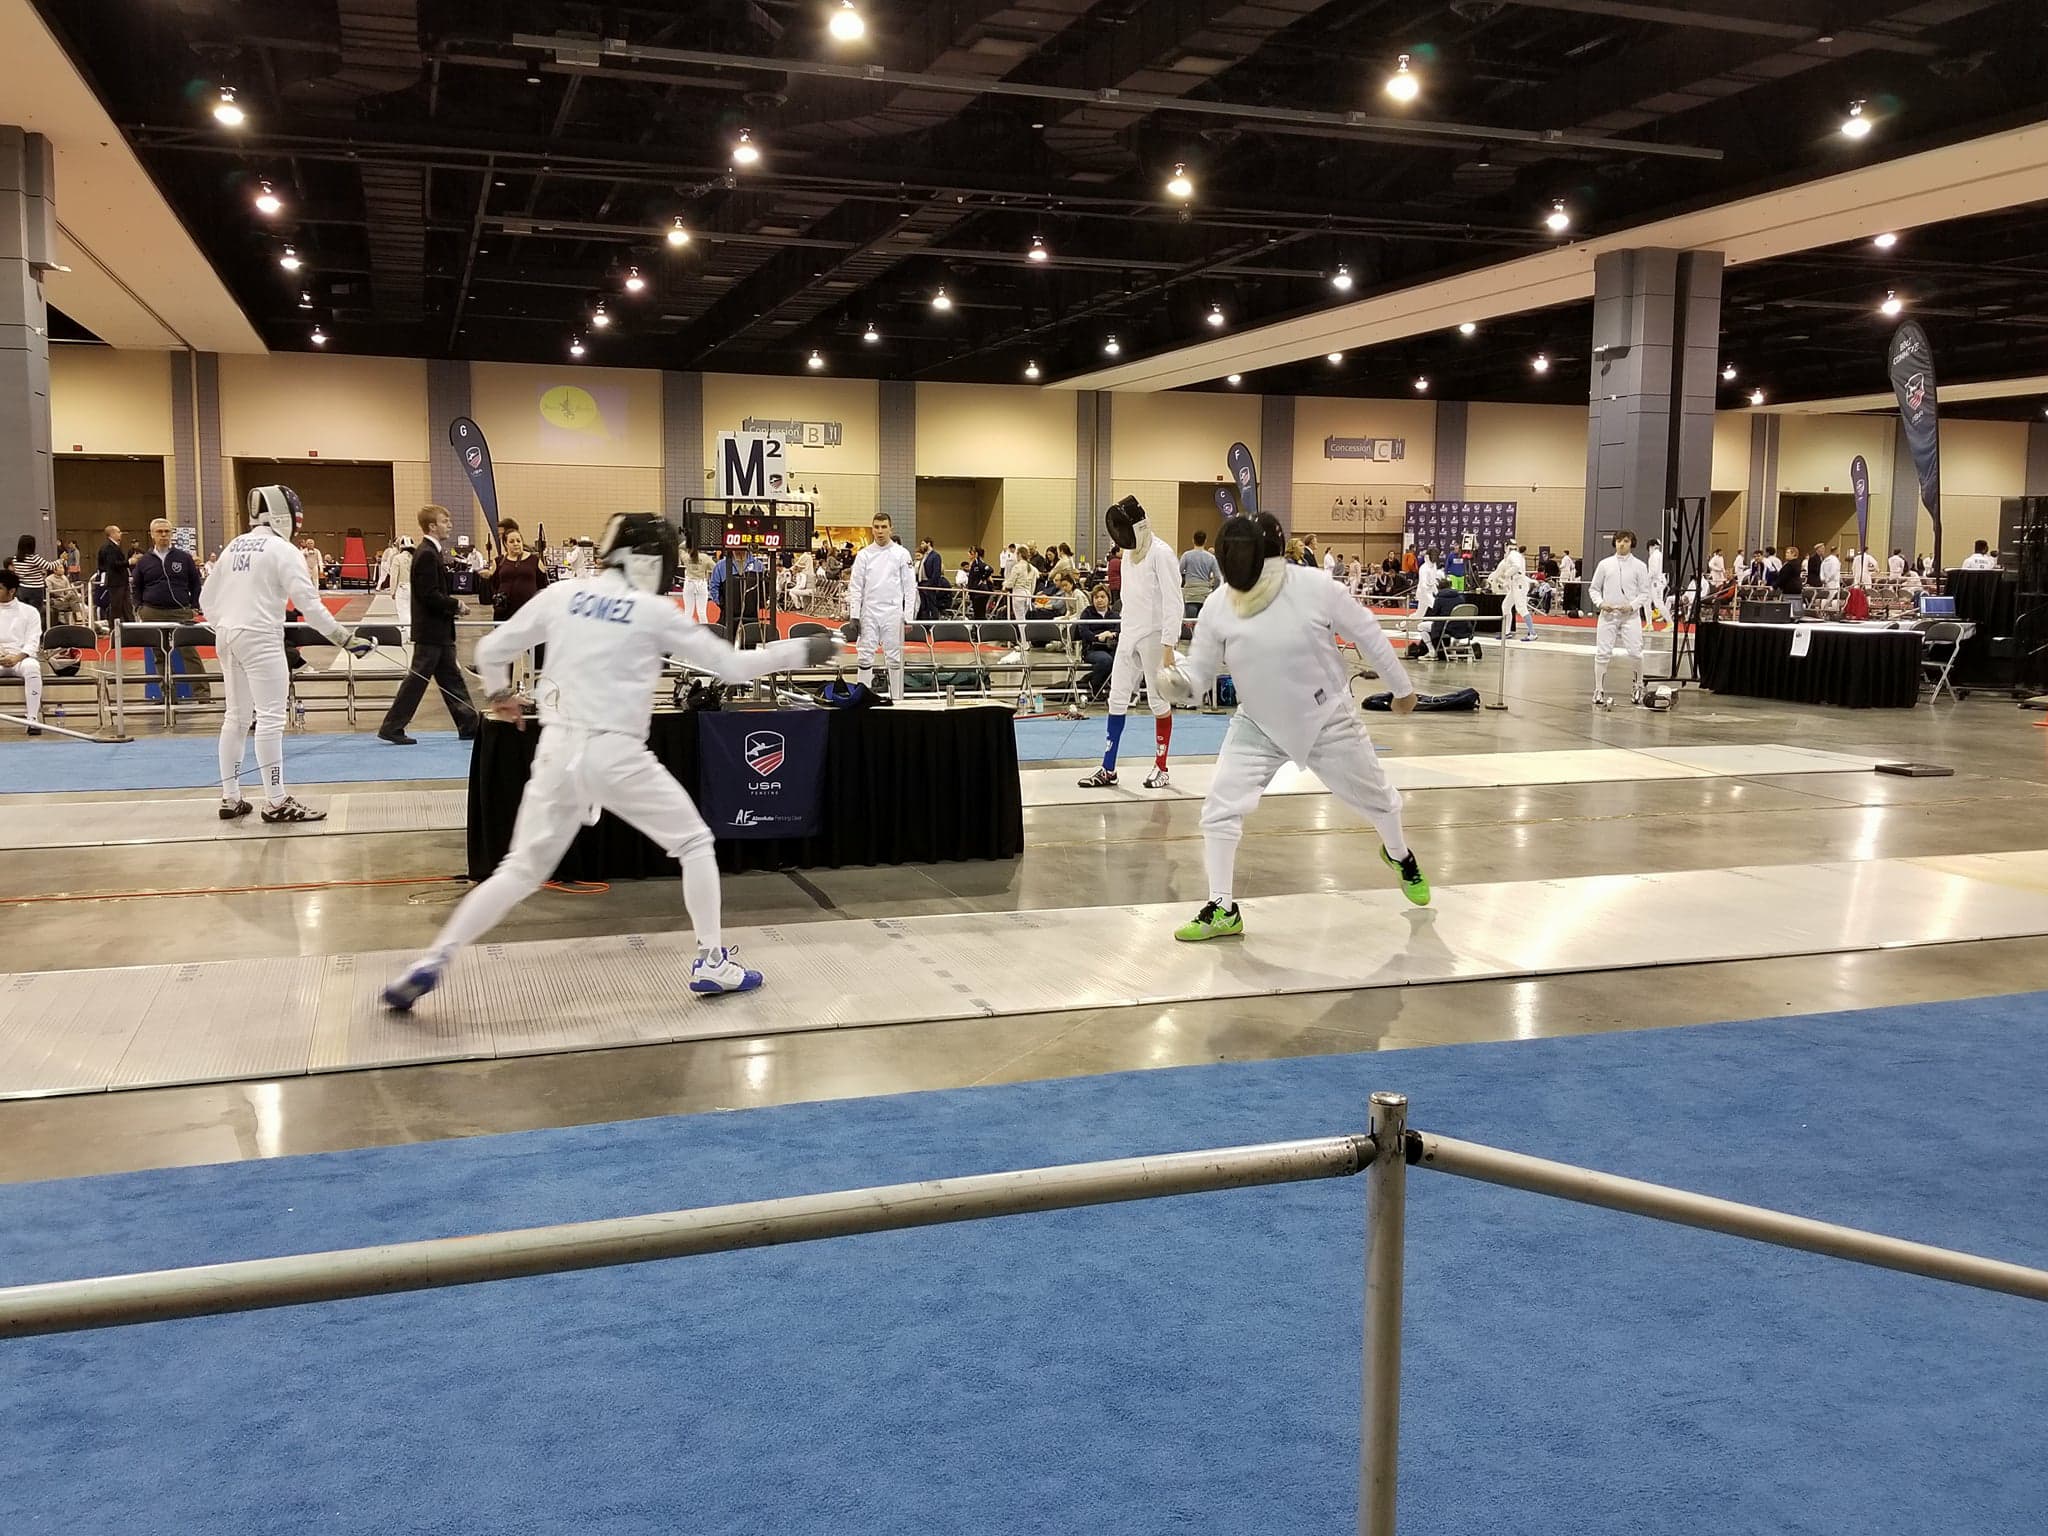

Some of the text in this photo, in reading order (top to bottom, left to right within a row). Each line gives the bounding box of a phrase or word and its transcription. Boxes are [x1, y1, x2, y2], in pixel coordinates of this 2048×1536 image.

[460, 424, 467, 437] G
[749, 425, 819, 443] Conion B
[1234, 449, 1240, 460] F
[1330, 443, 1390, 458] Concession C
[724, 438, 782, 497] M 2
[1331, 507, 1385, 521] BISTRO
[726, 534, 741, 545] 00
[765, 535, 780, 546] 00
[232, 554, 251, 572] USA
[568, 590, 635, 624] GOMEZ
[748, 782, 782, 790] USA
